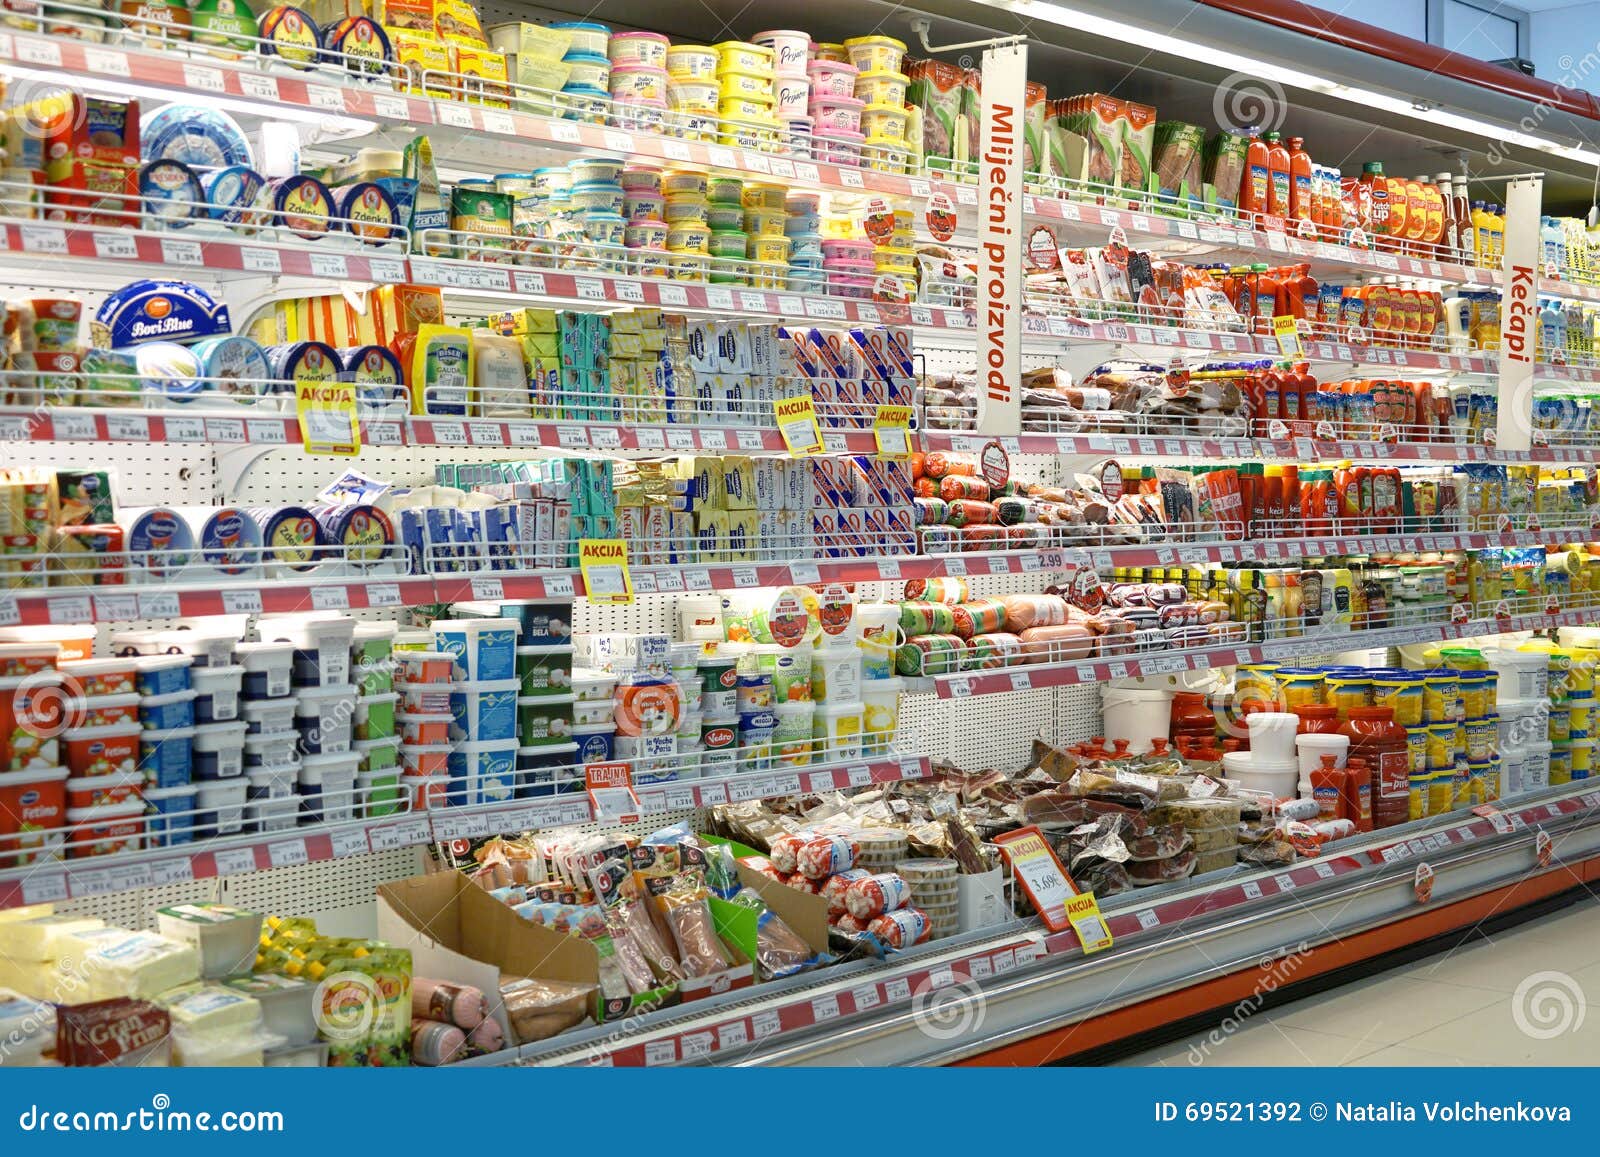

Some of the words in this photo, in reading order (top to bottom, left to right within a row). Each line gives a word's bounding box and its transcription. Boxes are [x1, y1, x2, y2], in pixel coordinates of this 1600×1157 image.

[346, 45, 379, 59] Zdenka
[984, 102, 1013, 235] Mliječni
[353, 211, 388, 225] Zdenka
[1503, 264, 1533, 361] Kečapi
[983, 242, 1011, 400] proizvodi
[1026, 318, 1048, 332] 2.99
[1108, 325, 1128, 339] 0.59
[299, 386, 351, 403] AKCIJA
[777, 400, 812, 417] AKCIJA
[879, 411, 908, 422] AKCIJA
[583, 544, 624, 558] AKCIJA
[1038, 554, 1062, 568] 2.99
[532, 628, 549, 637] BELA
[707, 731, 733, 744] Vedro
[1067, 898, 1095, 915] AKCIJA
